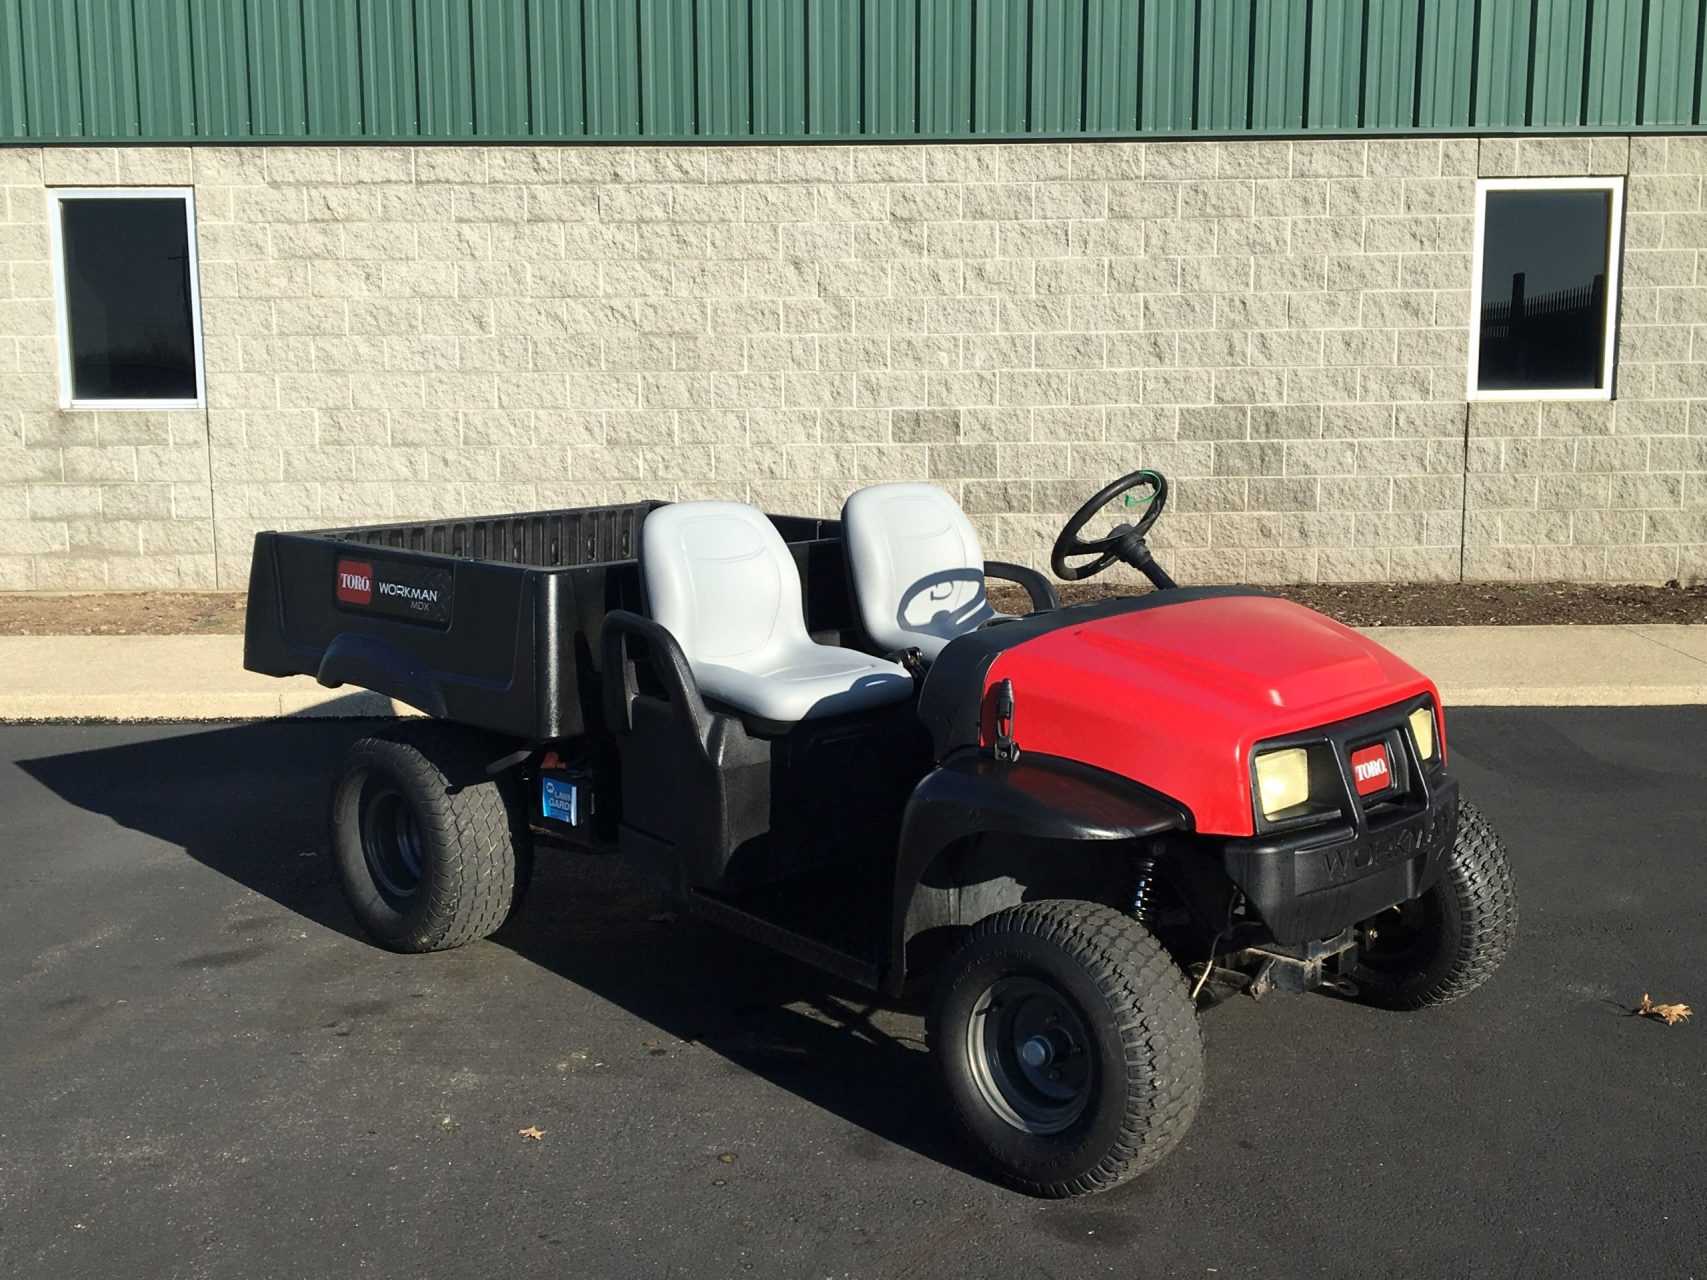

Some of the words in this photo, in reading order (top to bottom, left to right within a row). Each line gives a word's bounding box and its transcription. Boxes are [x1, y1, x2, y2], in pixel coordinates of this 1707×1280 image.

[341, 573, 370, 592] TORO
[379, 581, 438, 603] WORKMAN
[410, 600, 429, 612] MDX
[1355, 758, 1387, 782] TORO
[549, 797, 571, 811] GARD
[1322, 809, 1453, 881] WORKMAN
